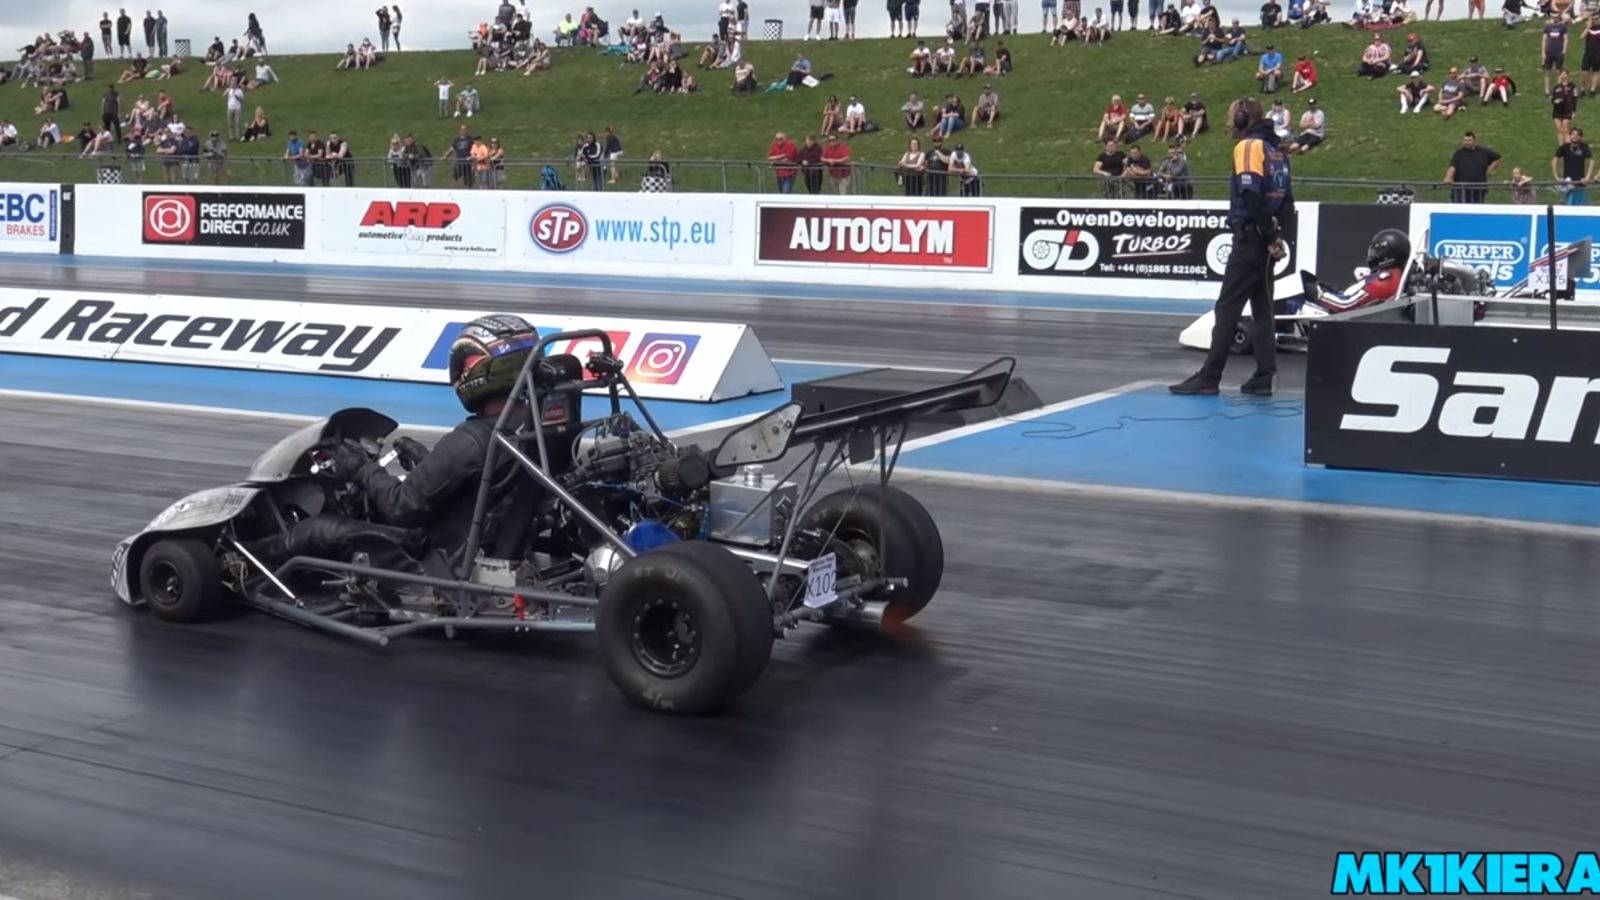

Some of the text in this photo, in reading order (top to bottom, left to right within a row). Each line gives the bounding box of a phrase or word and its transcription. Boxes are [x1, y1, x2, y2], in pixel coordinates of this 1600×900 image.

[0, 193, 45, 223] EBC
[200, 203, 304, 220] PERFORMANCE
[360, 201, 461, 229] ARP
[6, 224, 45, 236] BRAKES
[358, 231, 403, 240] automotive
[426, 232, 463, 242] products
[537, 211, 580, 245] STP
[595, 216, 716, 250] www.stp.eu
[789, 217, 954, 254] AUTOGLYM
[1443, 245, 1514, 260] DRAPER
[1100, 263, 1115, 272] Tel:
[1117, 264, 1134, 272] +44
[41, 299, 400, 372] Raceway
